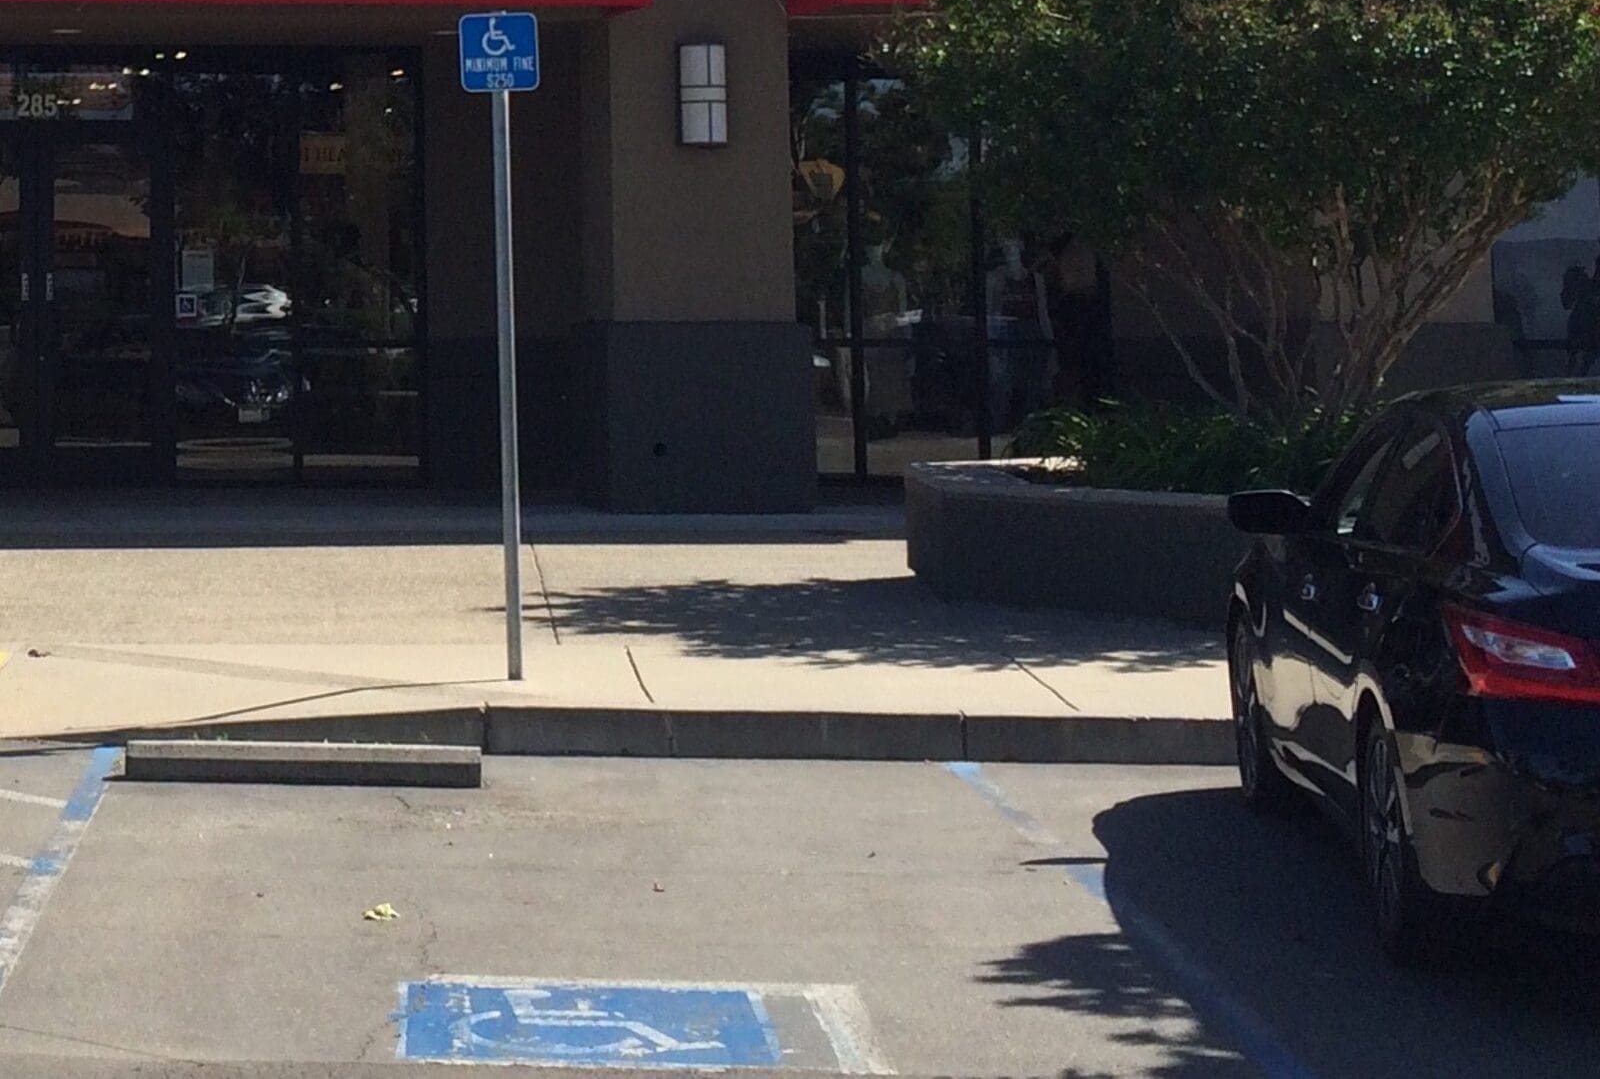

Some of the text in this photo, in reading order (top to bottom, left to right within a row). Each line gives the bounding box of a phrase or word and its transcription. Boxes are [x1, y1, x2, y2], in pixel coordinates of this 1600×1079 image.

[465, 55, 535, 73] MINIMUM FINE
[486, 72, 515, 88] $250
[17, 93, 58, 117] 285
